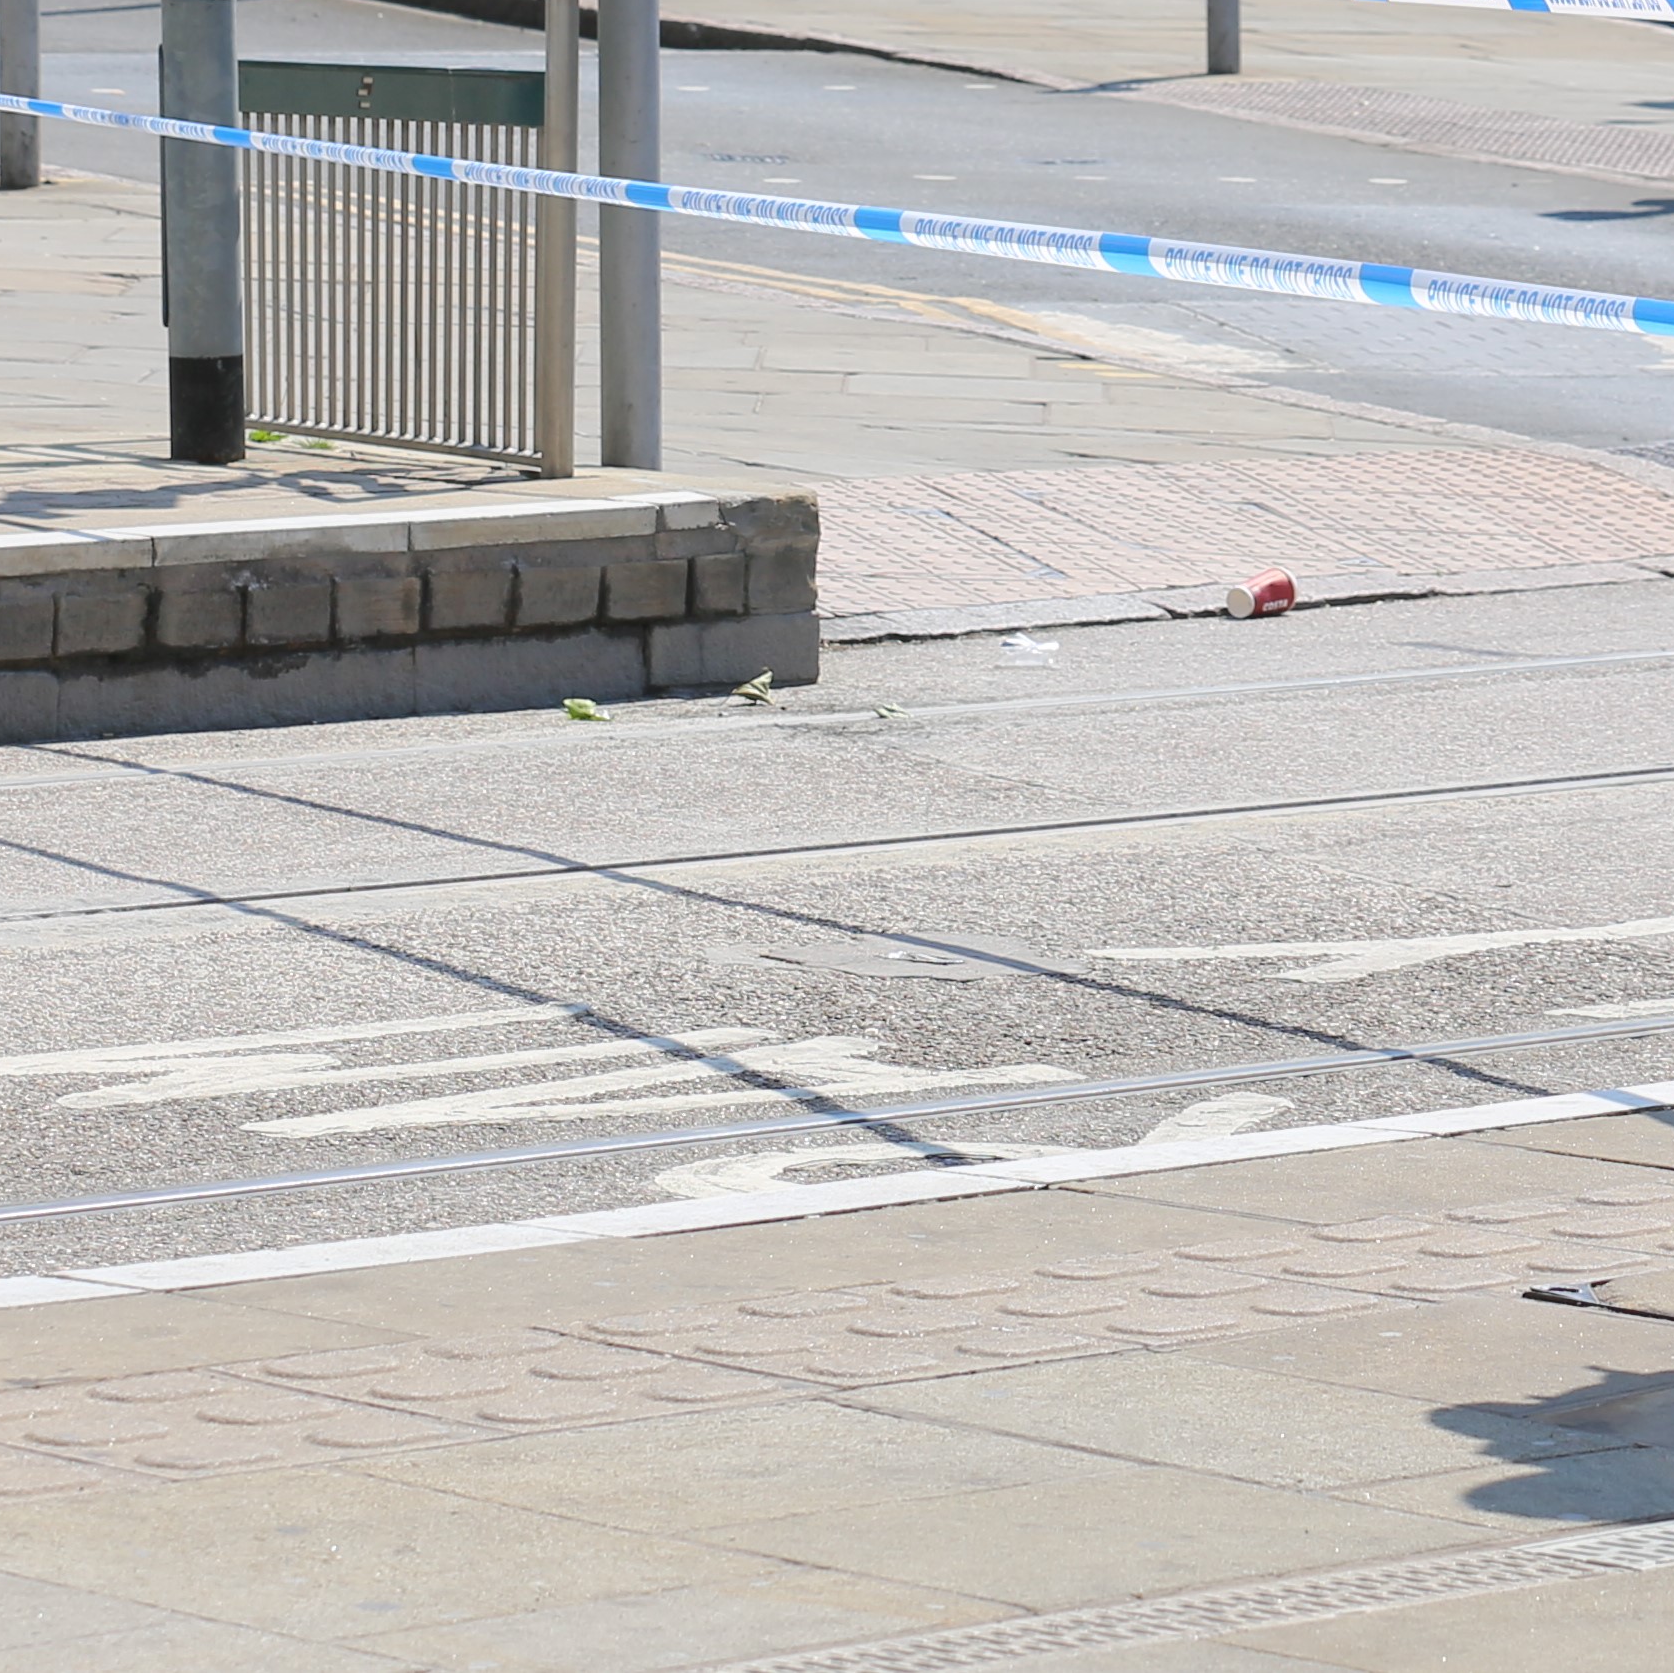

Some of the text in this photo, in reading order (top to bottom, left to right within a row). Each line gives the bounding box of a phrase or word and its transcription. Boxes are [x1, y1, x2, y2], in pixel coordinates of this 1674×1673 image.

[681, 191, 849, 234] POLICE LINE DO NOT CROSS
[914, 218, 1095, 267] POLICE LINE DO NOT CROSS
[1165, 247, 1355, 299] POLICE LINE DO NOT CROSS
[1428, 279, 1626, 330] POLICE LINE DO NOT CROSS
